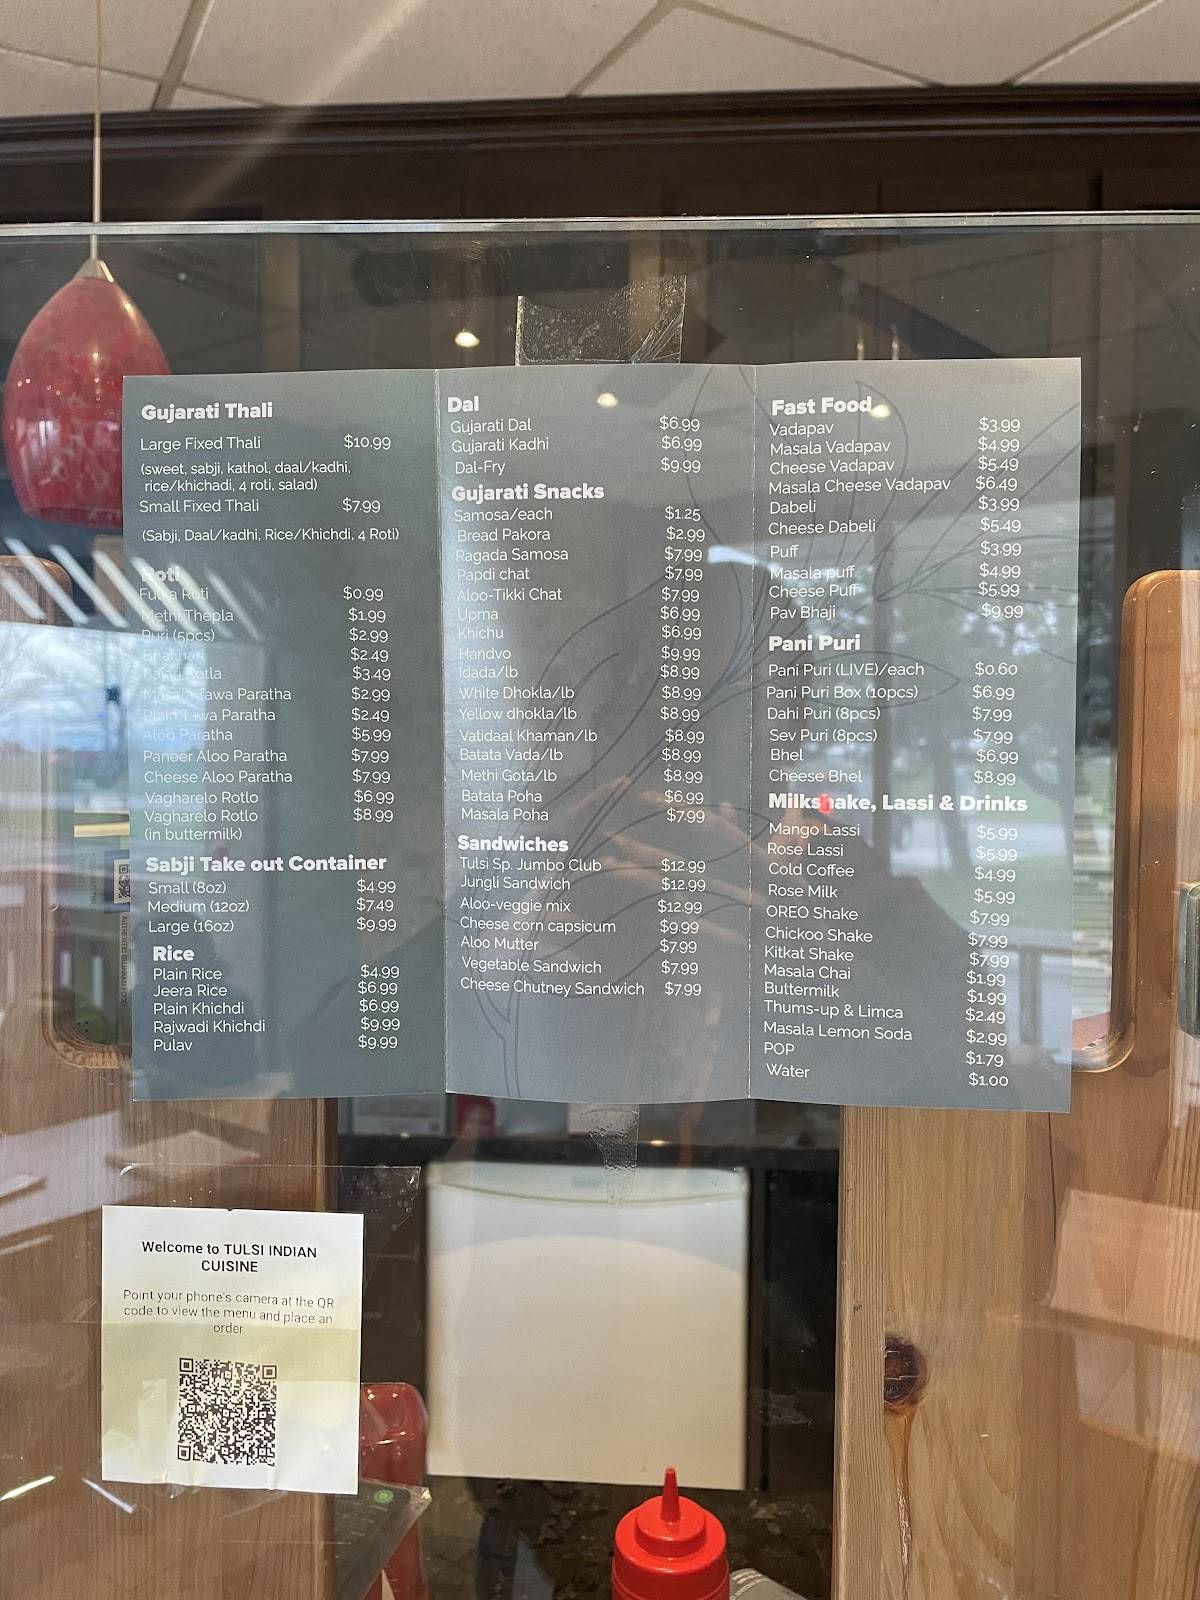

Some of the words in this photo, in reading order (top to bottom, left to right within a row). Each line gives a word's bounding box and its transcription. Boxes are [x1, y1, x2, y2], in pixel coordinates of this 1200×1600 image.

[141, 402, 220, 423] Gujarati
[225, 401, 272, 418] Thali
[448, 395, 479, 412] Dal
[772, 398, 815, 416] Fast
[821, 395, 872, 413] Food
[770, 422, 834, 438] Vadapav
[979, 415, 1020, 433] $3.99
[140, 437, 181, 452] Large
[186, 436, 222, 449] Fixed
[227, 435, 261, 449] Thali
[344, 433, 391, 450] $10.99
[452, 438, 504, 454] Gujarati
[510, 437, 548, 450] Kadhi
[662, 435, 702, 450] $6.99
[770, 461, 825, 475] Cheese
[830, 459, 894, 474] Vadapav
[978, 455, 1019, 472] $5.49
[145, 479, 236, 492] rice/khichadi,
[239, 479, 246, 492] 4
[250, 479, 275, 491] roti,
[278, 478, 318, 490] salad)
[452, 483, 528, 504] Gujarati
[534, 482, 604, 500] Snacks
[770, 500, 816, 514] Dabeli
[978, 494, 1020, 511] $3.99
[454, 507, 552, 522] Samosa/each
[665, 505, 700, 521] $1.25
[142, 529, 180, 543] (Sabji,
[185, 528, 261, 542] Daal/kadhi,
[265, 528, 354, 541] Rice/Khichdi,
[358, 529, 366, 541] 4
[370, 527, 399, 540] Roti)
[456, 549, 507, 564] Ragada
[512, 548, 568, 561] Samosa
[664, 545, 702, 562] $7.99
[771, 544, 799, 558] Puff
[980, 539, 1022, 556] $3.99
[457, 587, 524, 602] Aloo-Tikki
[530, 587, 562, 600] Chat
[662, 586, 700, 602] $7.99
[770, 606, 796, 618] Pav
[801, 605, 836, 620] Bhaji
[982, 602, 1023, 618] $9.99
[458, 627, 504, 640] Khichu
[662, 624, 702, 640] $6.99
[769, 635, 812, 651] Pani
[819, 633, 860, 650] Puri
[459, 665, 518, 679] Idada/lb
[660, 663, 700, 679] $8.99
[766, 685, 797, 698] Pani
[802, 685, 829, 698] Puri
[834, 685, 861, 698] Box
[866, 685, 918, 700] (10pcs)
[972, 683, 1014, 700] $6.99
[459, 707, 502, 721] Yellow
[507, 706, 577, 721] dhokla/lb
[660, 705, 700, 722] $8.99
[770, 729, 796, 742] Sev
[800, 728, 828, 742] Puri
[832, 728, 877, 743] (8pcs)
[974, 727, 1013, 744] $7.99
[460, 748, 502, 761] Batata
[507, 748, 562, 761] Vada/lb
[662, 746, 701, 764] $8.99
[144, 771, 198, 783] Cheese
[202, 770, 234, 783] Aloo
[238, 770, 292, 783] Paratha
[352, 768, 390, 784] $7.99
[769, 769, 824, 782] Cheese
[828, 769, 862, 782] Bhel
[974, 769, 1016, 786] $8.99
[461, 789, 504, 802] Batata
[508, 789, 542, 803] Poha
[665, 788, 704, 805] $6.99
[882, 794, 933, 810] Lassi
[939, 795, 954, 810] &
[960, 795, 1028, 812] Drinks
[144, 809, 216, 824] Vagharelo
[221, 809, 258, 822] Rotlo
[353, 807, 394, 823] $8.99
[458, 834, 568, 852] Sandwiches
[768, 842, 802, 856] Rose
[807, 843, 844, 857] Lassi
[976, 845, 1017, 861] $5.99
[146, 855, 195, 876] Sabji
[200, 855, 245, 872] Take
[251, 855, 284, 871] out
[289, 853, 386, 871] Container
[148, 881, 189, 894] Small
[192, 881, 226, 894] (8oz)
[357, 878, 396, 894] $4.99
[460, 875, 499, 891] Jungli
[503, 875, 570, 890] Sandwich
[662, 875, 706, 892] $12.99
[766, 905, 809, 918] OREO
[814, 906, 858, 920] Shake
[970, 909, 1010, 926] $7.99
[460, 916, 509, 930] Cheese
[513, 920, 543, 932] corn
[548, 919, 615, 935] capsicum
[660, 919, 699, 935] $9.99
[153, 945, 194, 961] Rice
[764, 945, 804, 959] Kitkat
[809, 947, 854, 961] Shake
[970, 951, 1009, 968] $7.99
[154, 967, 188, 980] Plain
[192, 967, 222, 980] Rice
[360, 963, 400, 980] $4.99
[461, 955, 529, 973] Vegetable
[533, 958, 602, 974] Sandwich
[662, 960, 699, 976] $7.99
[764, 981, 840, 997] Buttermilk
[968, 989, 1006, 1004] $1.99
[154, 1002, 188, 1014] Plain
[192, 1001, 244, 1014] Khichdi
[360, 998, 399, 1014] $6.99
[764, 1021, 814, 1036] Masala
[818, 1023, 870, 1038] Lemon
[874, 1025, 912, 1040] Soda
[966, 1028, 1007, 1045] $2.99
[154, 1038, 192, 1051] Pulav
[358, 1035, 398, 1050] $9.99
[766, 1062, 810, 1078] Water
[968, 1072, 1008, 1086] $1.00
[142, 1240, 203, 1254] Welcome
[207, 1242, 219, 1254] to
[224, 1243, 264, 1255] TULSI
[269, 1244, 317, 1257] INDIAN
[202, 1259, 258, 1272] CUISINE
[124, 1289, 153, 1301] Point
[157, 1291, 183, 1303] your
[187, 1291, 232, 1304] phone's
[236, 1293, 278, 1305] camera
[282, 1295, 292, 1305] at
[296, 1296, 314, 1307] the
[318, 1296, 334, 1308] QR
[124, 1305, 152, 1316] code
[157, 1305, 168, 1316] to
[172, 1305, 197, 1317] view
[202, 1306, 219, 1318] the
[224, 1308, 256, 1320] menu
[260, 1309, 280, 1321] and
[284, 1311, 315, 1324] place
[319, 1314, 332, 1324] an
